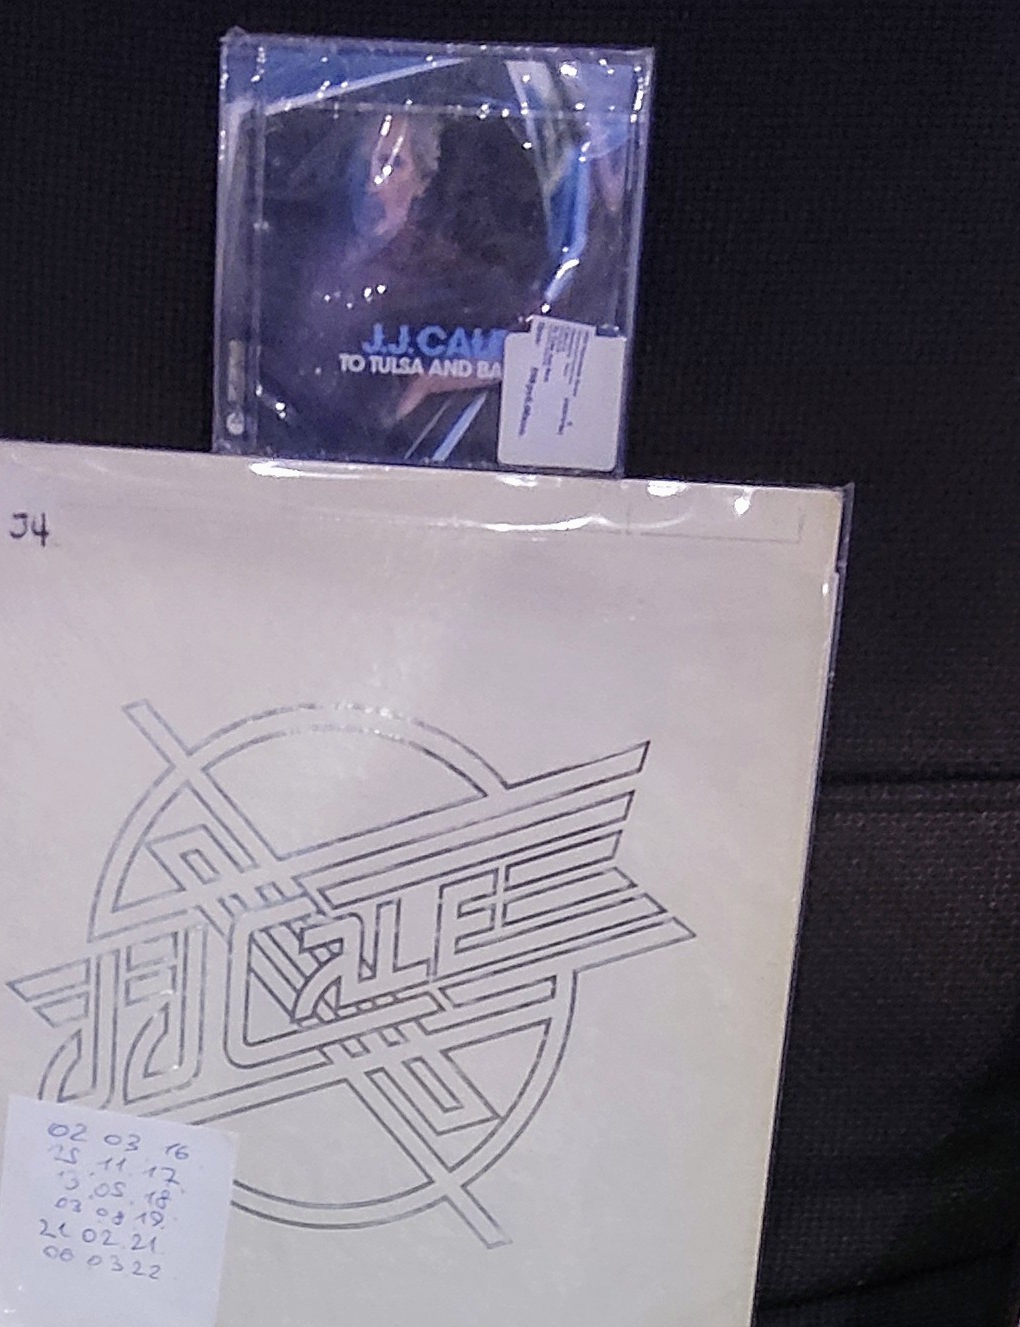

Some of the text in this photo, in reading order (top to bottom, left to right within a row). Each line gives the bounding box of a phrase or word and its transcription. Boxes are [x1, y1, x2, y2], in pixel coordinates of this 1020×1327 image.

[339, 353, 502, 379] TO TULSA AND BA
[47, 1122, 189, 1160] 02 03 16
[82, 1228, 119, 1246] 02
